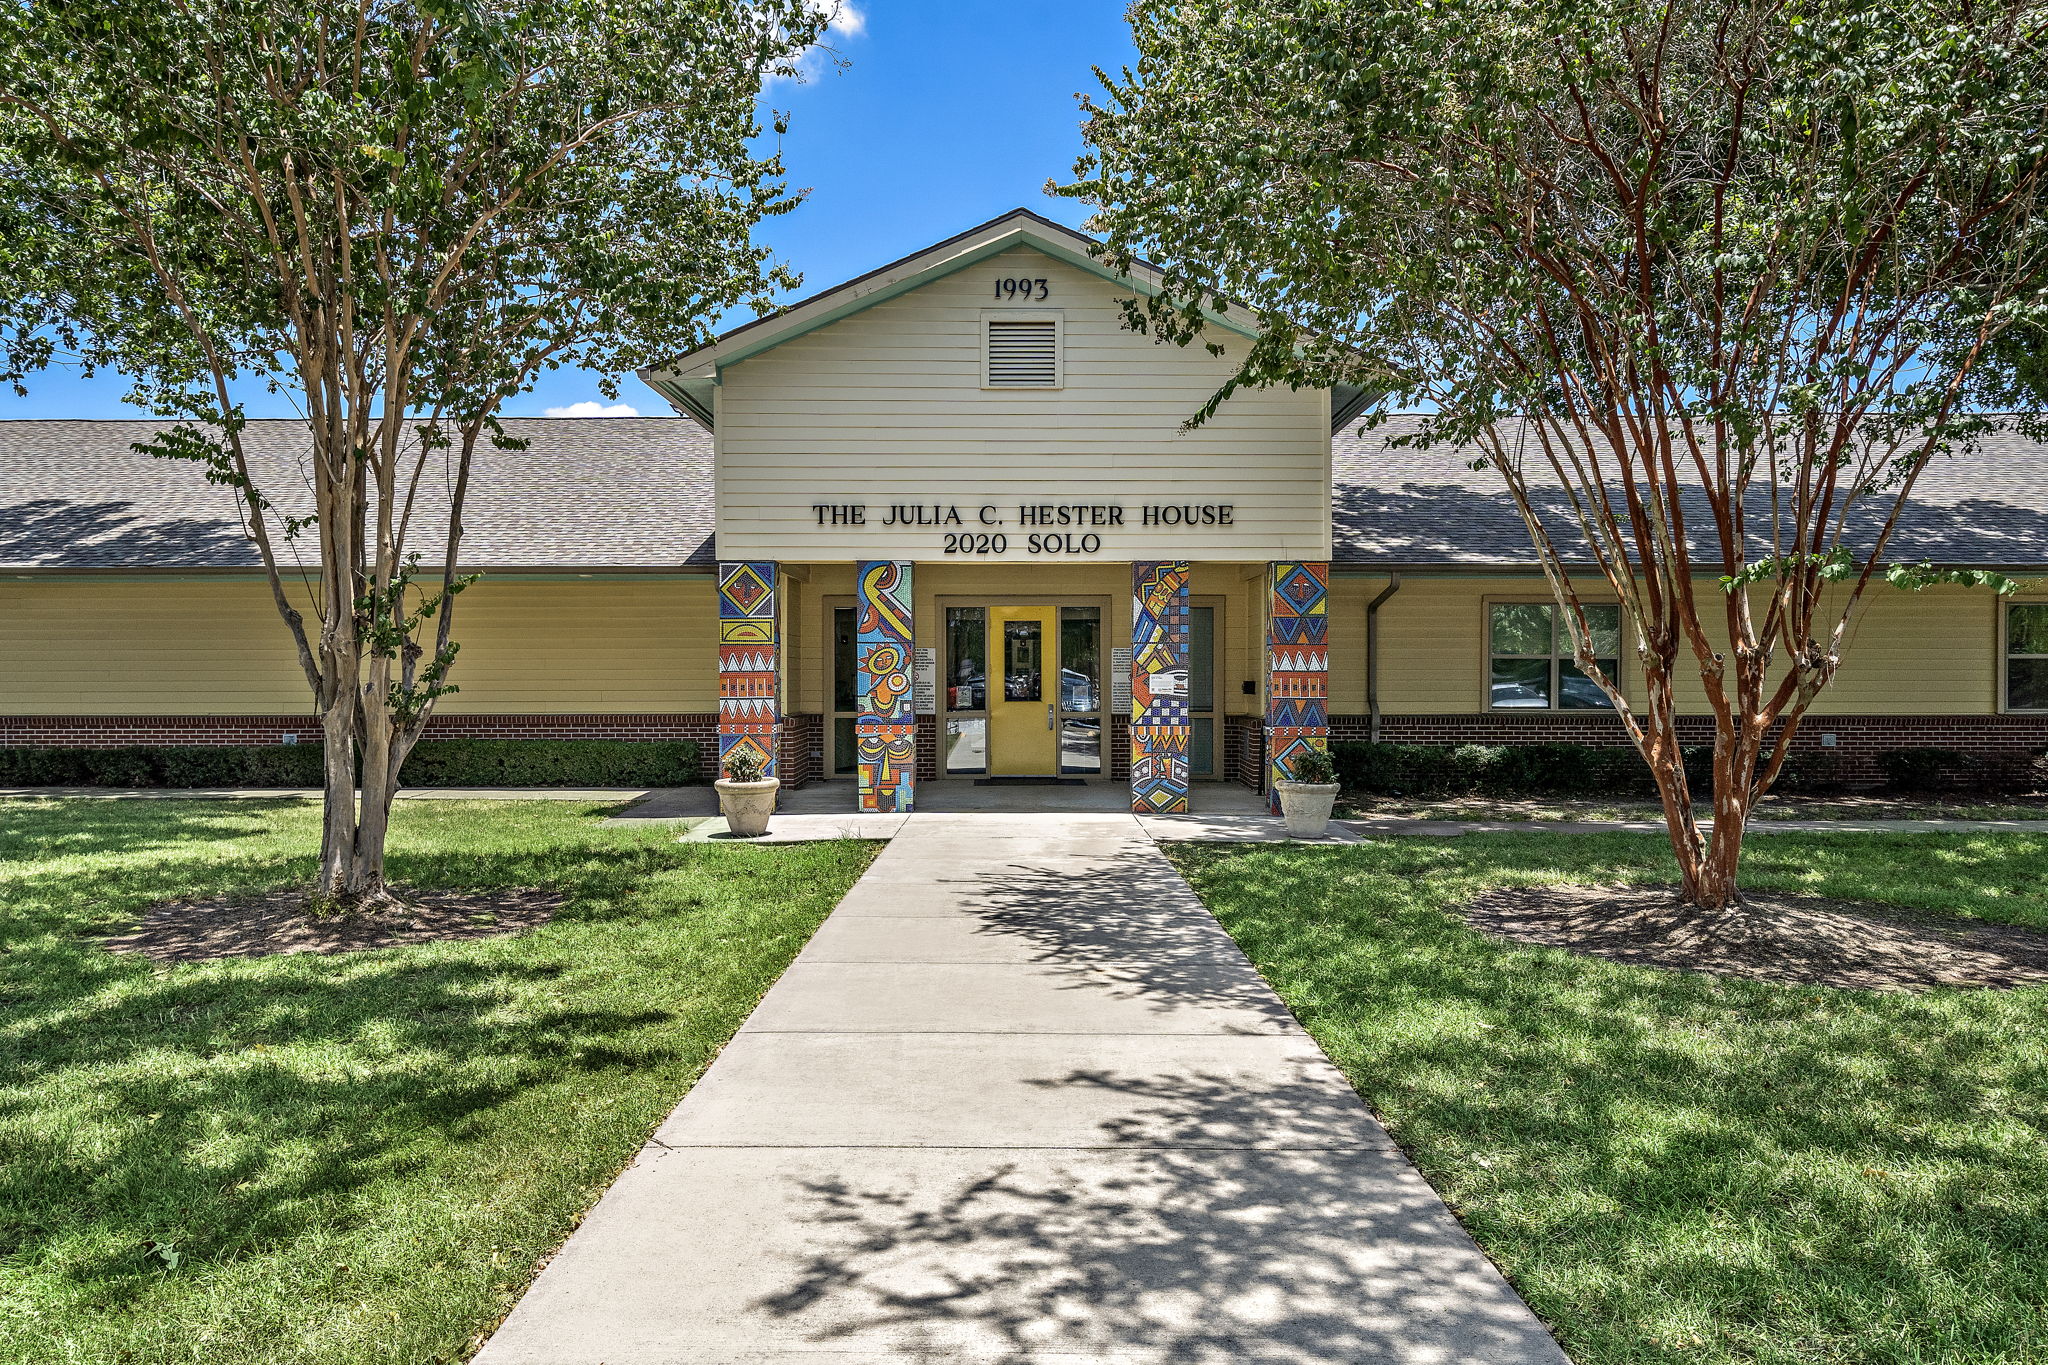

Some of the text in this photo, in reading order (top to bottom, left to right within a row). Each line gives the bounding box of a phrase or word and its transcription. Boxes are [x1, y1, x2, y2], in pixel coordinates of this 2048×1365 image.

[994, 277, 1049, 301] 1993
[812, 505, 1235, 526] THE JULIA C. HESTER HOUSE
[944, 533, 1100, 554] 2020 SOLO
